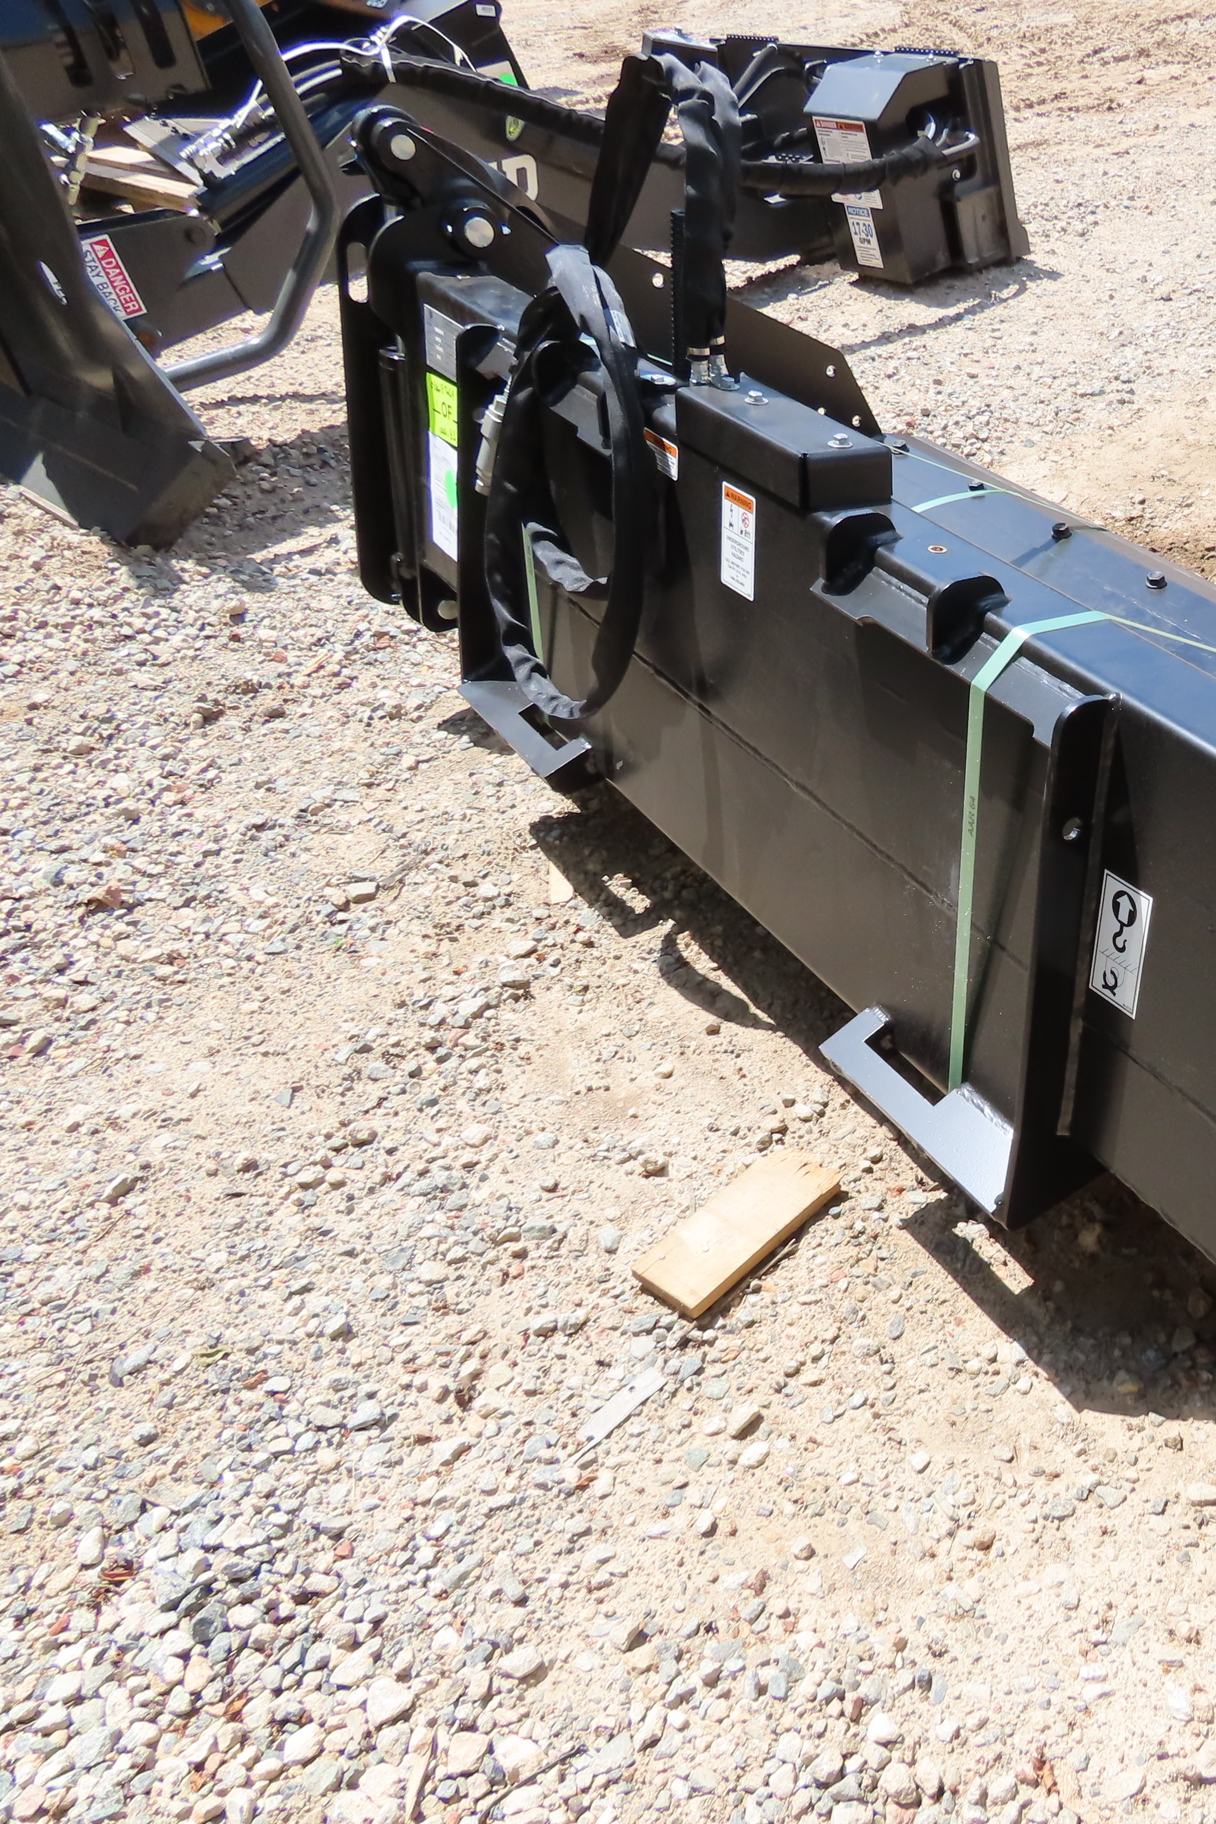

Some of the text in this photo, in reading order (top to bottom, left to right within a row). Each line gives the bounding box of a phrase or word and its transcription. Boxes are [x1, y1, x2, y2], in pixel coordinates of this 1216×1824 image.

[84, 249, 104, 278] STAY
[101, 257, 139, 313] DANGER
[730, 492, 752, 511] WARNING
